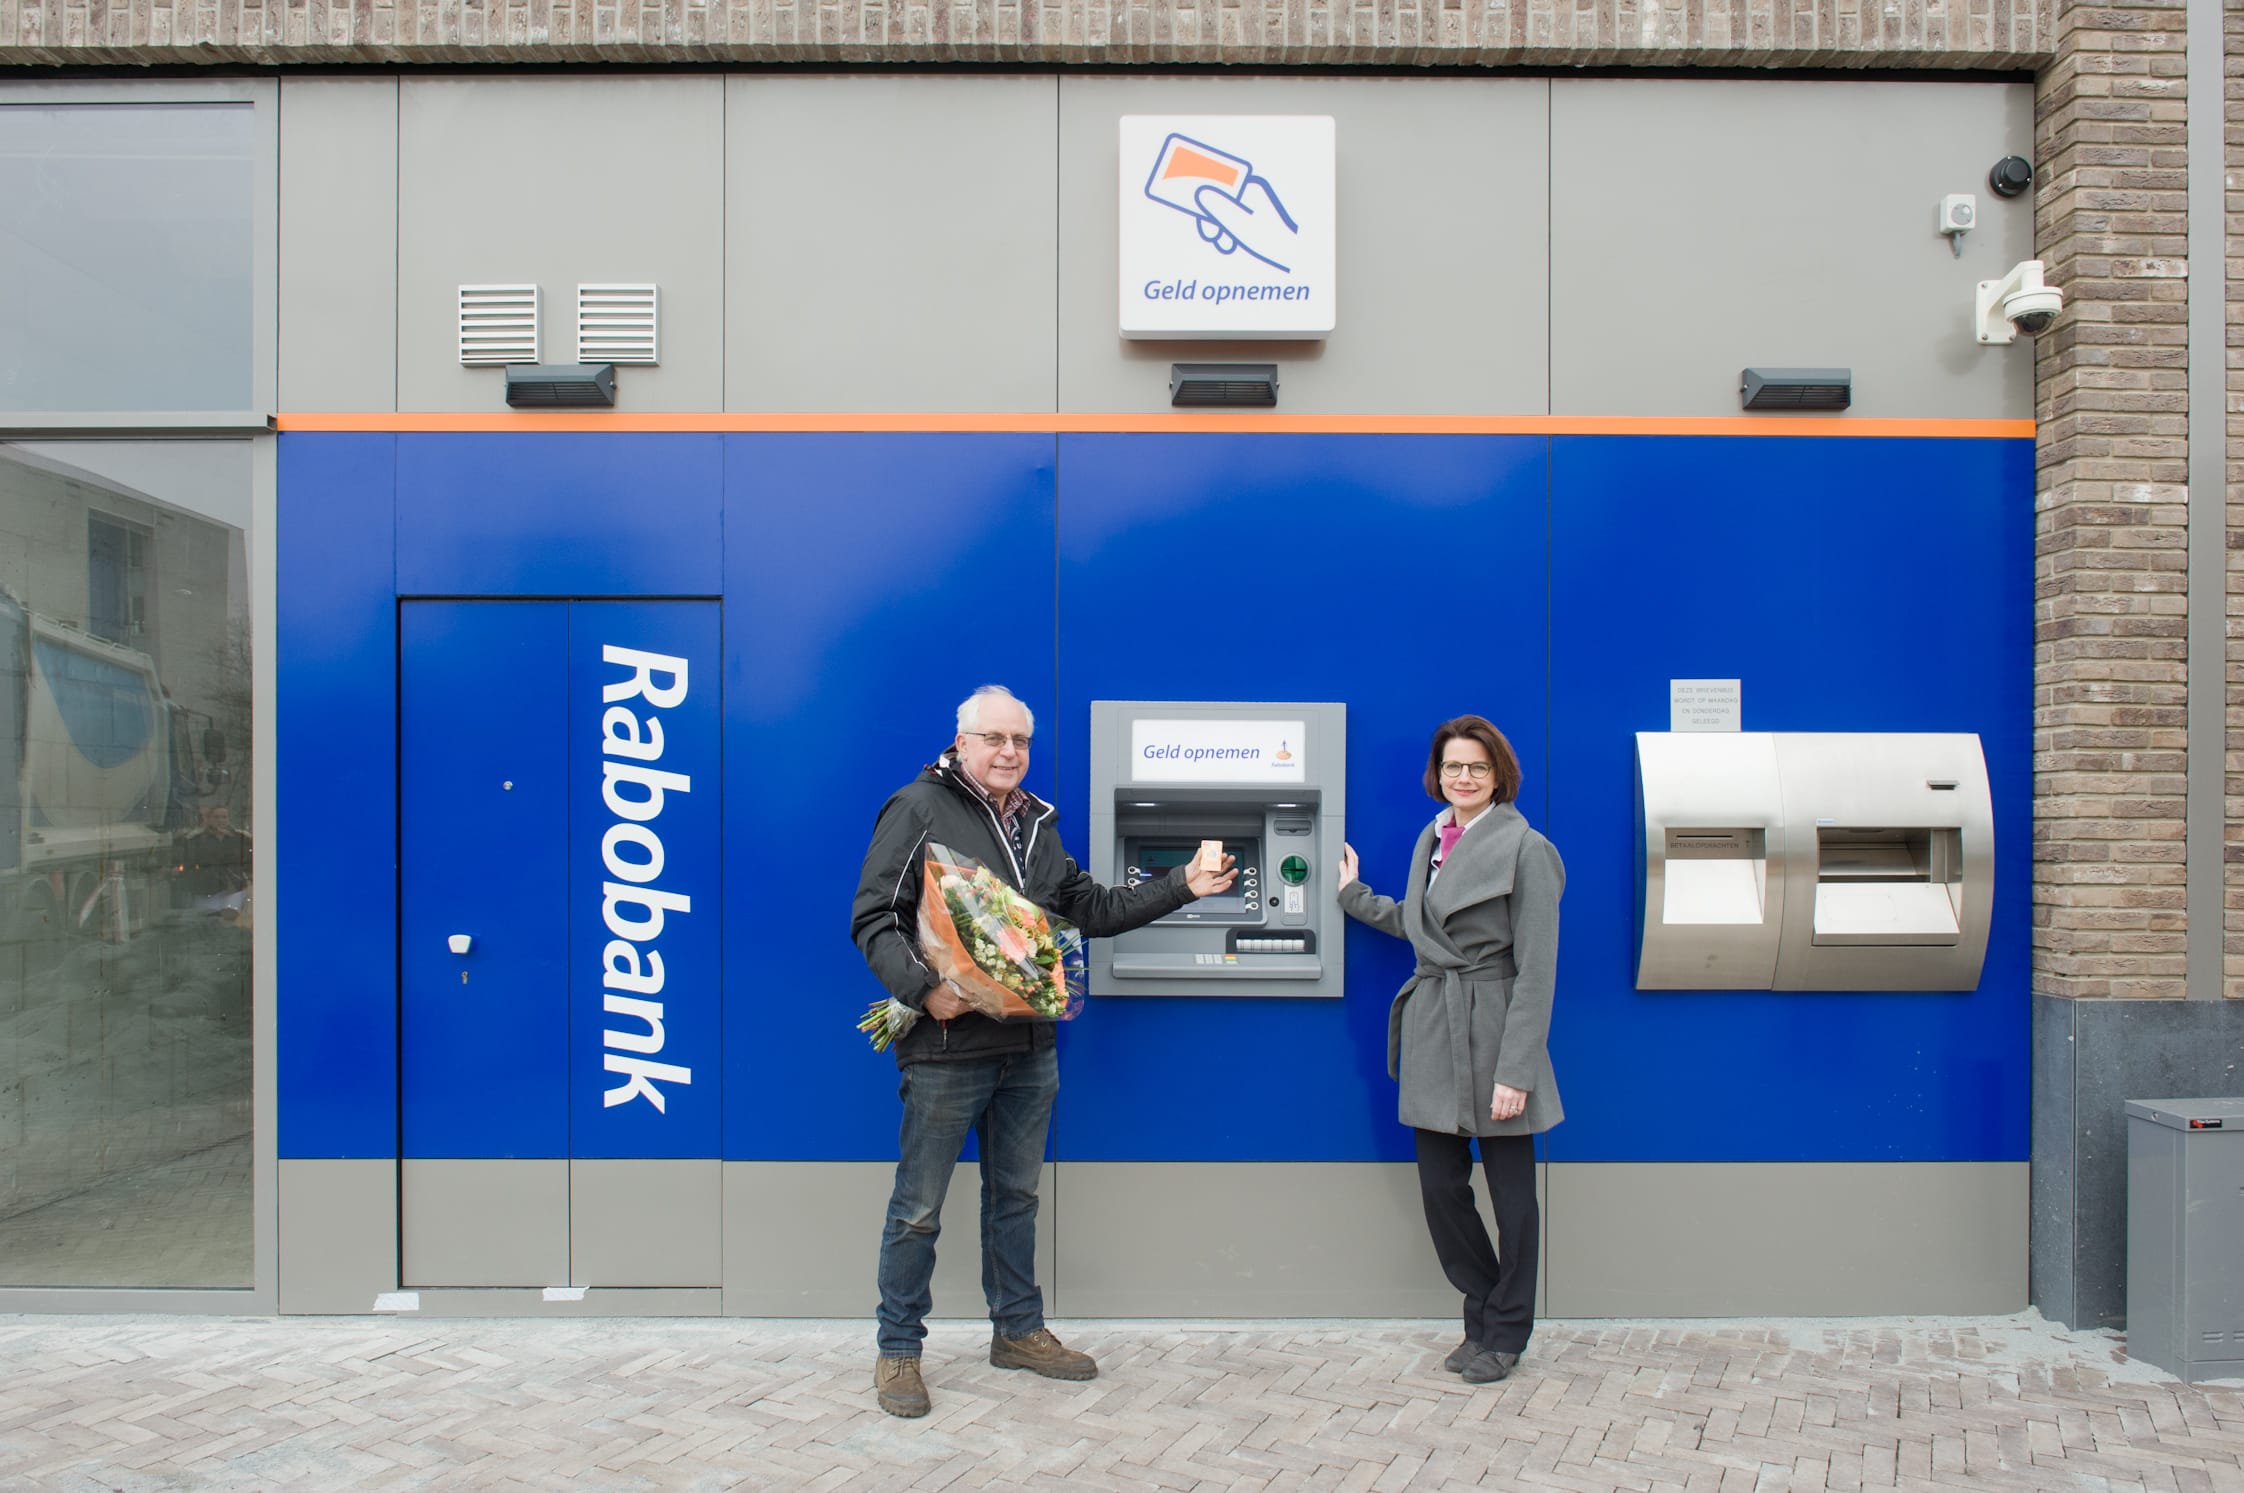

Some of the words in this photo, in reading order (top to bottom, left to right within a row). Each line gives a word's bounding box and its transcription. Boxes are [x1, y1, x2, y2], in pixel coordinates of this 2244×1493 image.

[1144, 280, 1197, 300] Geld
[1202, 285, 1310, 305] opnemen
[1143, 744, 1181, 759] Geld
[1184, 748, 1260, 762] opnemen
[601, 644, 692, 1115] Rabobank
